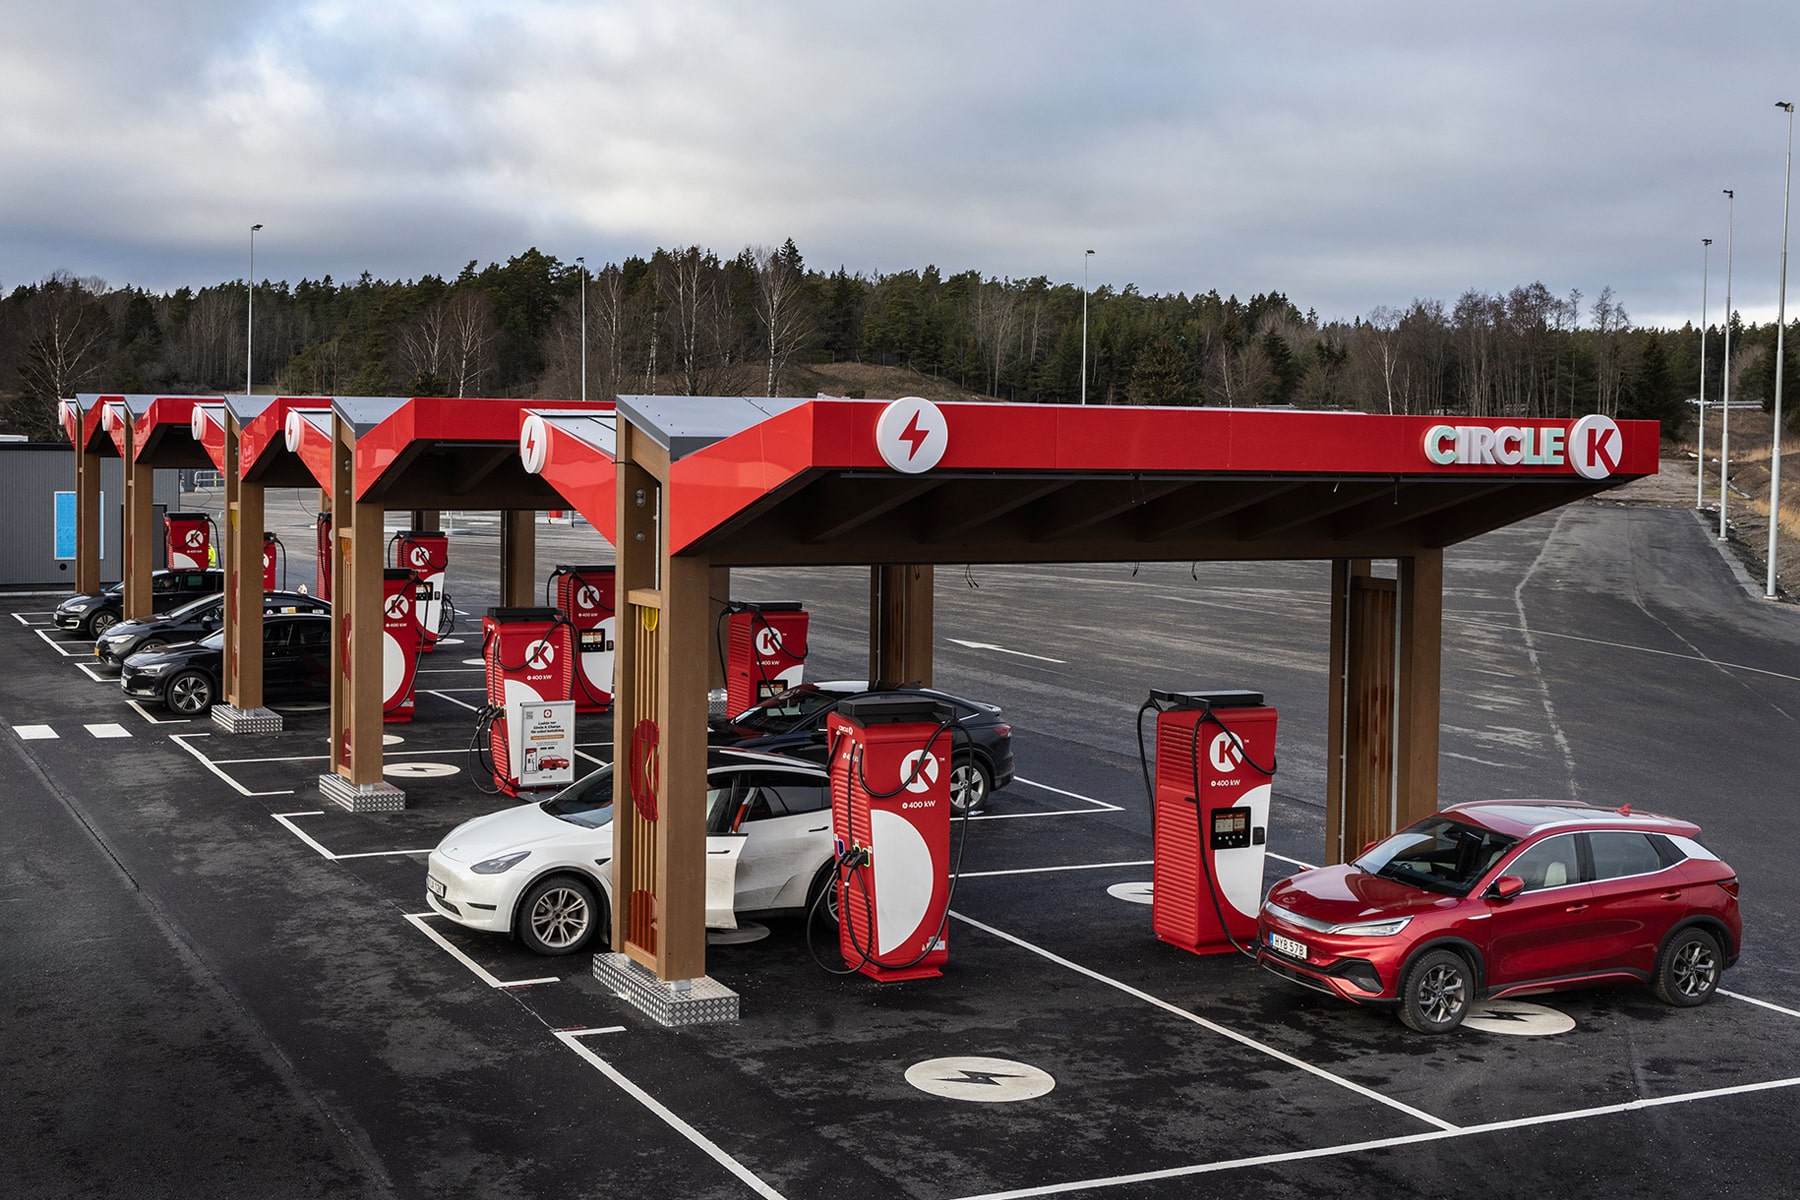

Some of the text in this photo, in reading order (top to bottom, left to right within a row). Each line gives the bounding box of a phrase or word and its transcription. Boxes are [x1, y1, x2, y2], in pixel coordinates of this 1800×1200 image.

[1424, 425, 1619, 478] CIRCLE K
[761, 631, 780, 655] K
[531, 644, 552, 669] K
[1217, 738, 1241, 769] K
[908, 757, 935, 789] K
[1216, 779, 1229, 787] 400
[908, 800, 922, 809] 400
[1274, 935, 1288, 950] HYB
